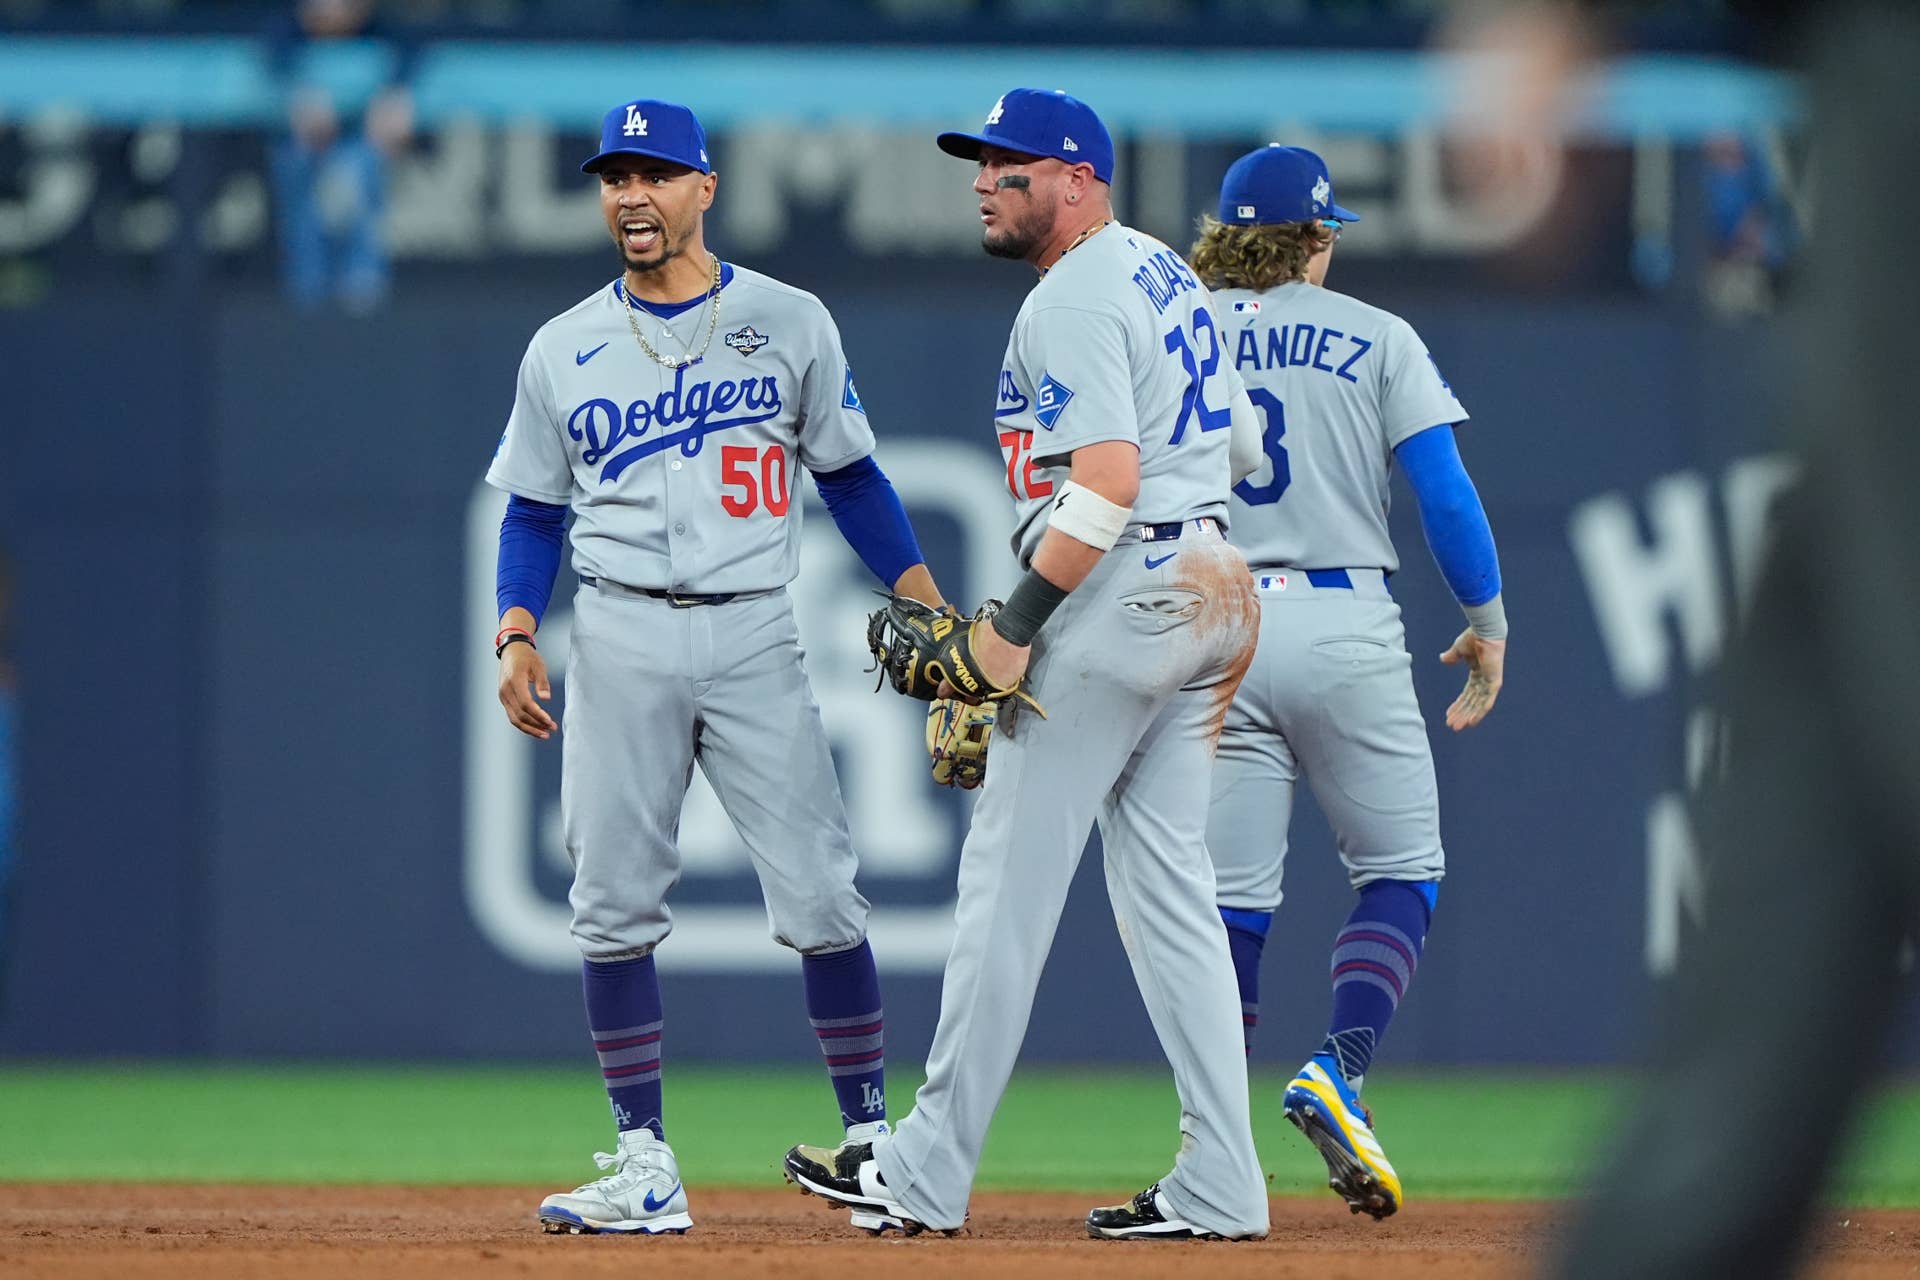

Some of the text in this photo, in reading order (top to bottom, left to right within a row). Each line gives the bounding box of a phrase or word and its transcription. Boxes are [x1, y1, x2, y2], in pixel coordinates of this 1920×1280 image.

[622, 105, 648, 136] LA
[1132, 250, 1198, 316] ROJAS
[1164, 306, 1232, 445] 72
[1221, 318, 1372, 384] ÁNDEZ
[567, 356, 782, 485] Dodgers
[721, 445, 789, 519] 50
[861, 1082, 884, 1114] LA
